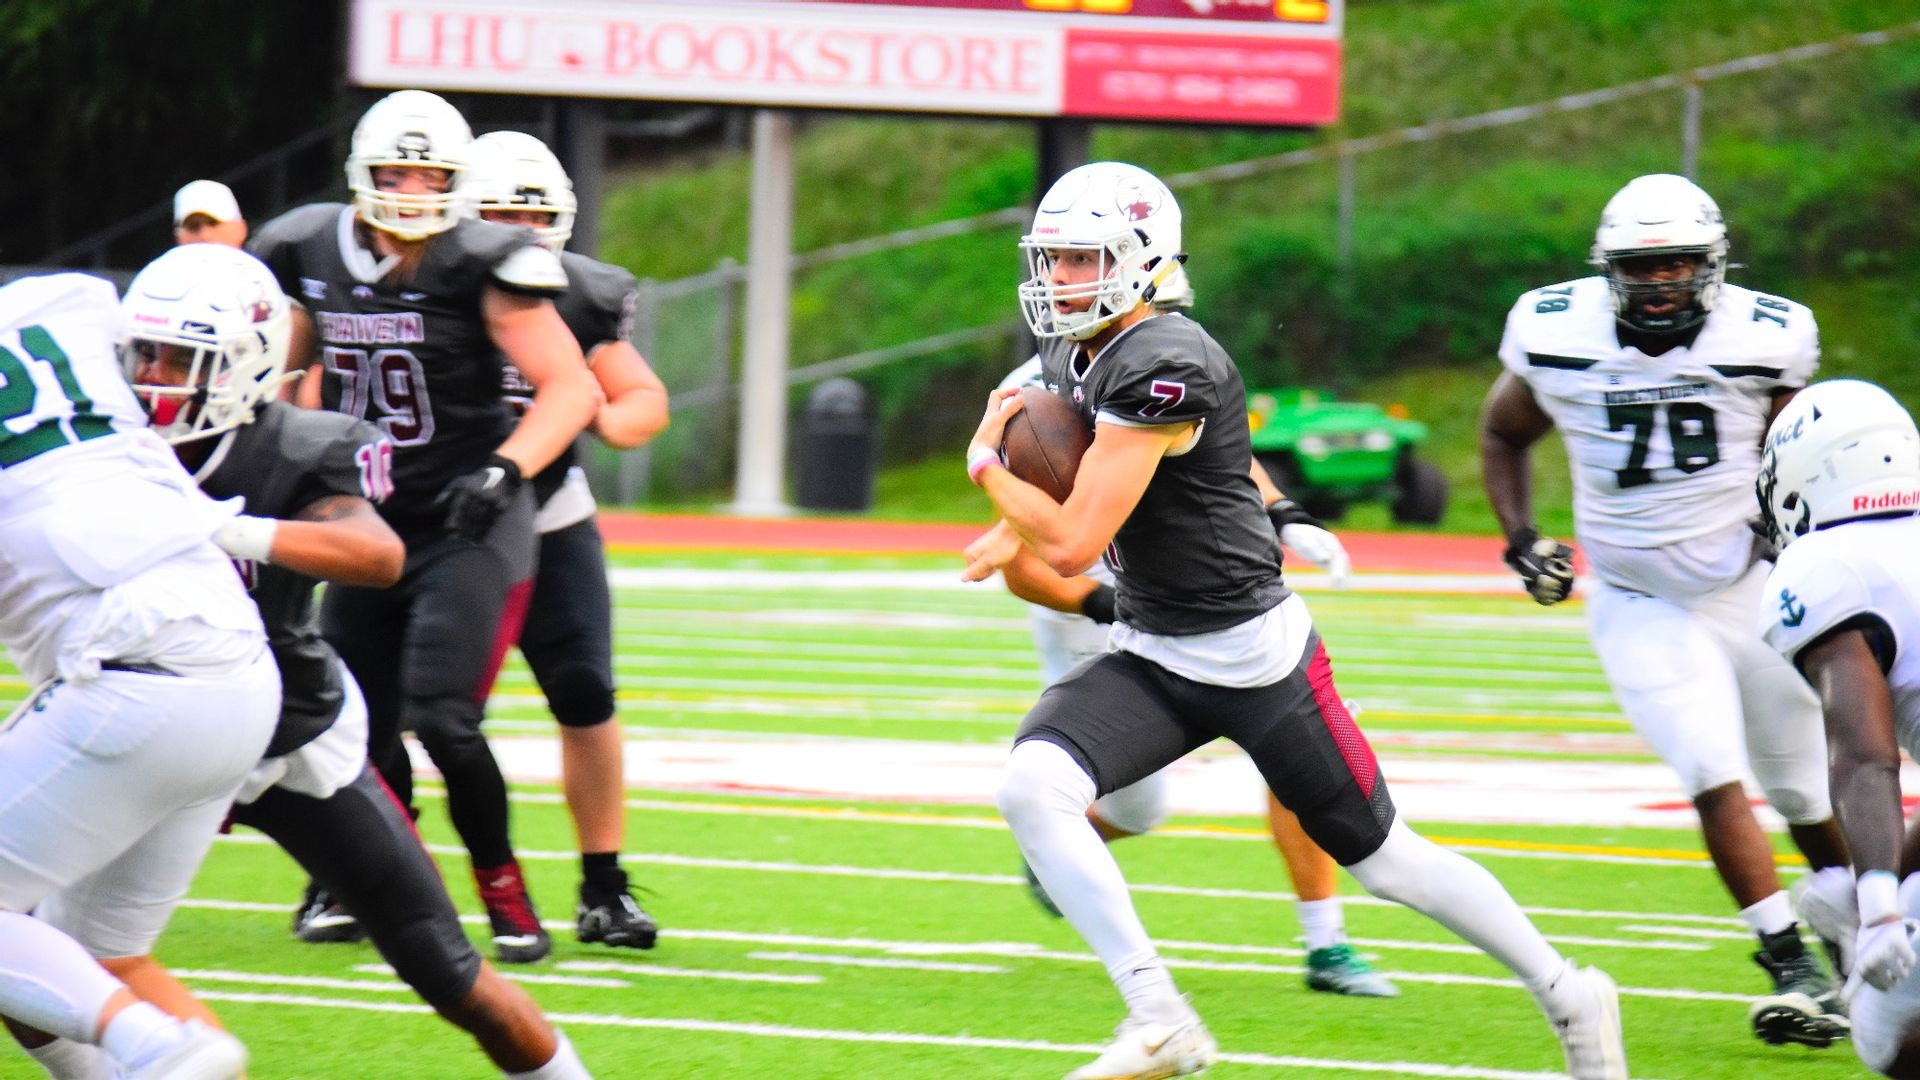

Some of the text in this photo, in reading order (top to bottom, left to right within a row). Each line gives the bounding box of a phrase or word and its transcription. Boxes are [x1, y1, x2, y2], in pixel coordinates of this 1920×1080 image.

[387, 11, 535, 73] LHU
[605, 21, 1041, 94] BOOKSTORE
[323, 346, 435, 447] 79
[1137, 379, 1186, 417] 7
[1605, 402, 1720, 488] 78
[1853, 491, 1920, 511] Riddell
